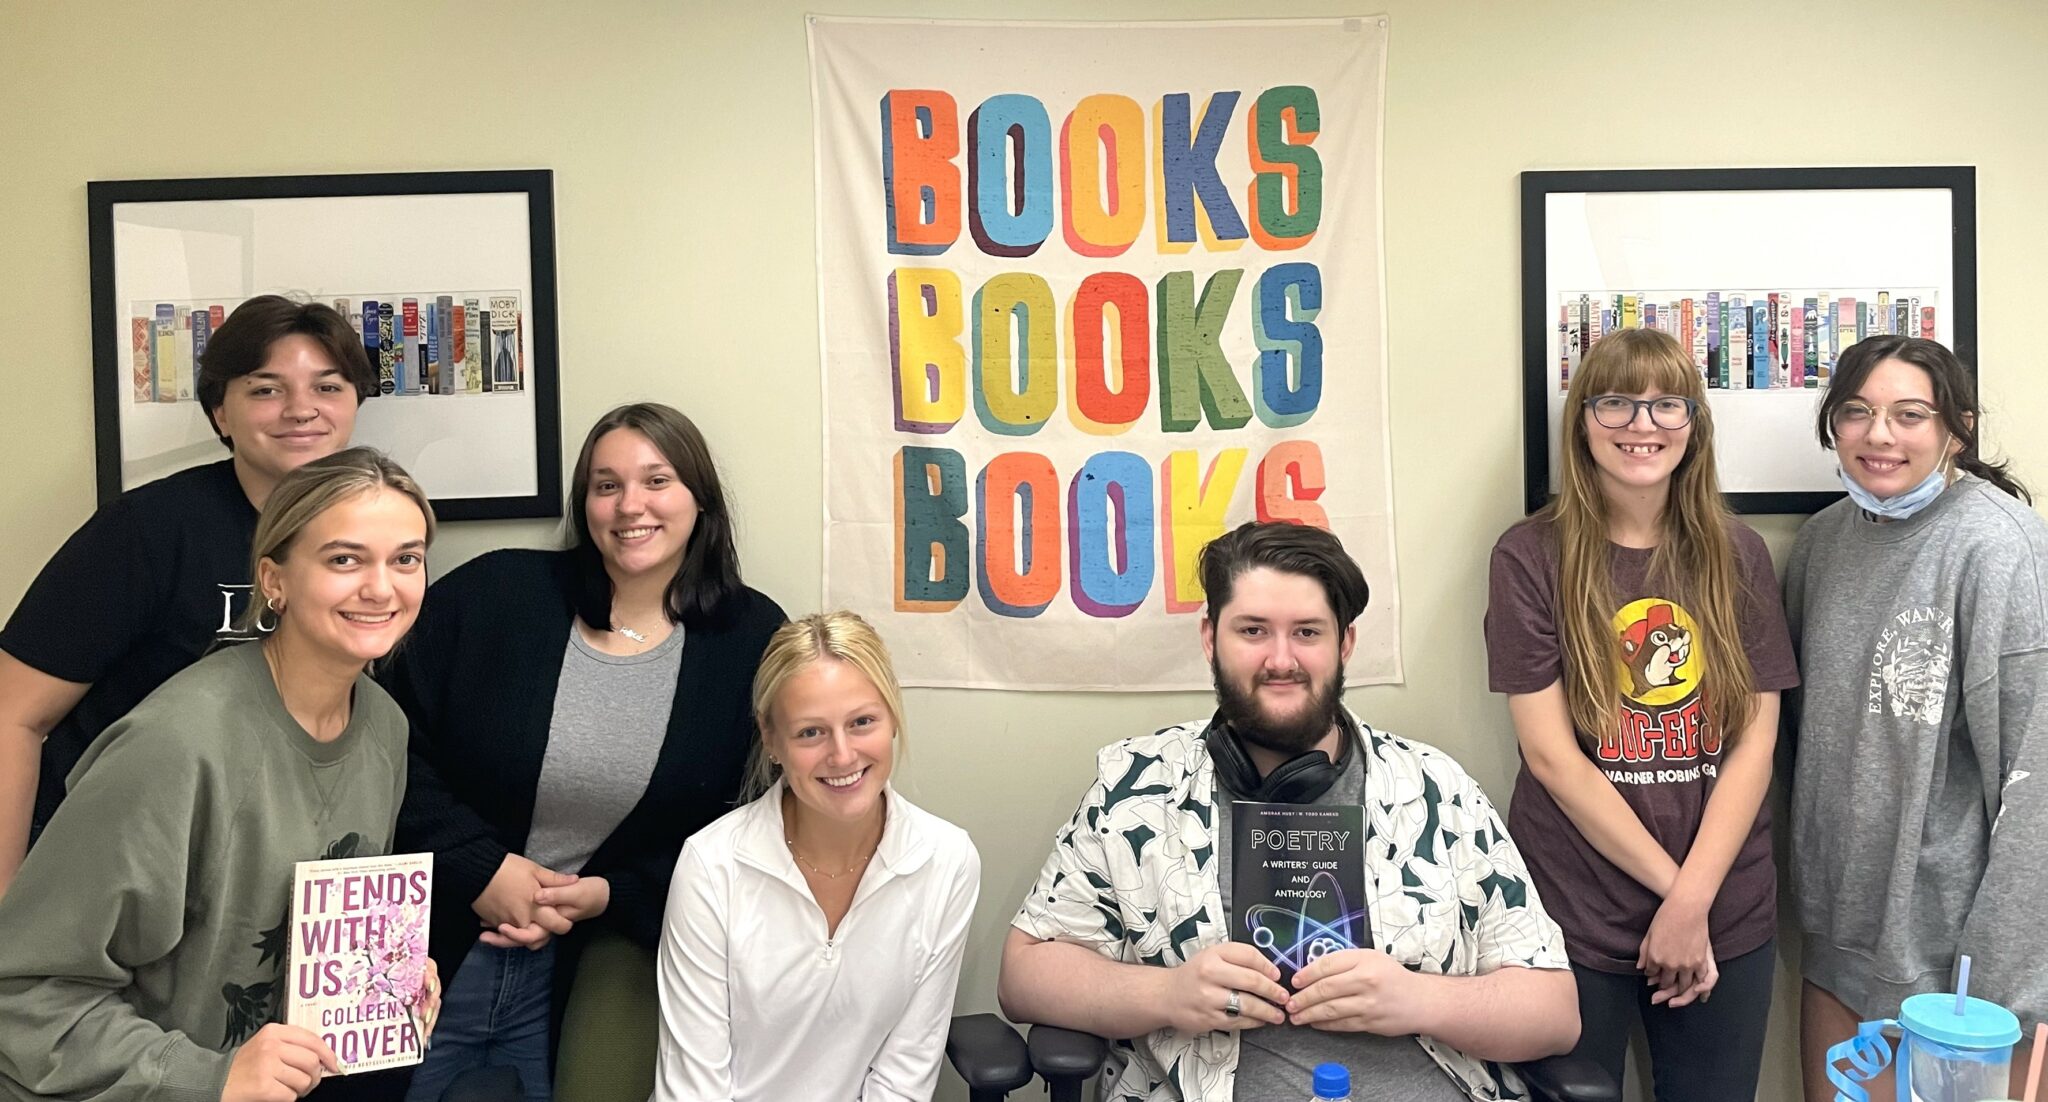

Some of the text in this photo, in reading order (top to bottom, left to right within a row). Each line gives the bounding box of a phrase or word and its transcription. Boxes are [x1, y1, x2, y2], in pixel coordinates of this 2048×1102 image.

[880, 85, 1323, 257] BOOKS
[490, 300, 517, 309] MOBY
[491, 310, 515, 319] DICK
[887, 262, 1323, 436] BOOKS
[1603, 769, 1655, 785] WARNER
[1702, 763, 1716, 778] GA
[1251, 829, 1350, 851] POETRY
[1262, 860, 1338, 870] A WRITERS' GUIDE
[1291, 875, 1311, 884] AND
[303, 870, 427, 915] IT ENDS
[1275, 889, 1327, 899] ANTHOLOGY
[301, 914, 386, 957] WITH
[299, 960, 343, 999] US
[322, 1001, 398, 1027] COLLEEN
[321, 1022, 416, 1064] OOVER
